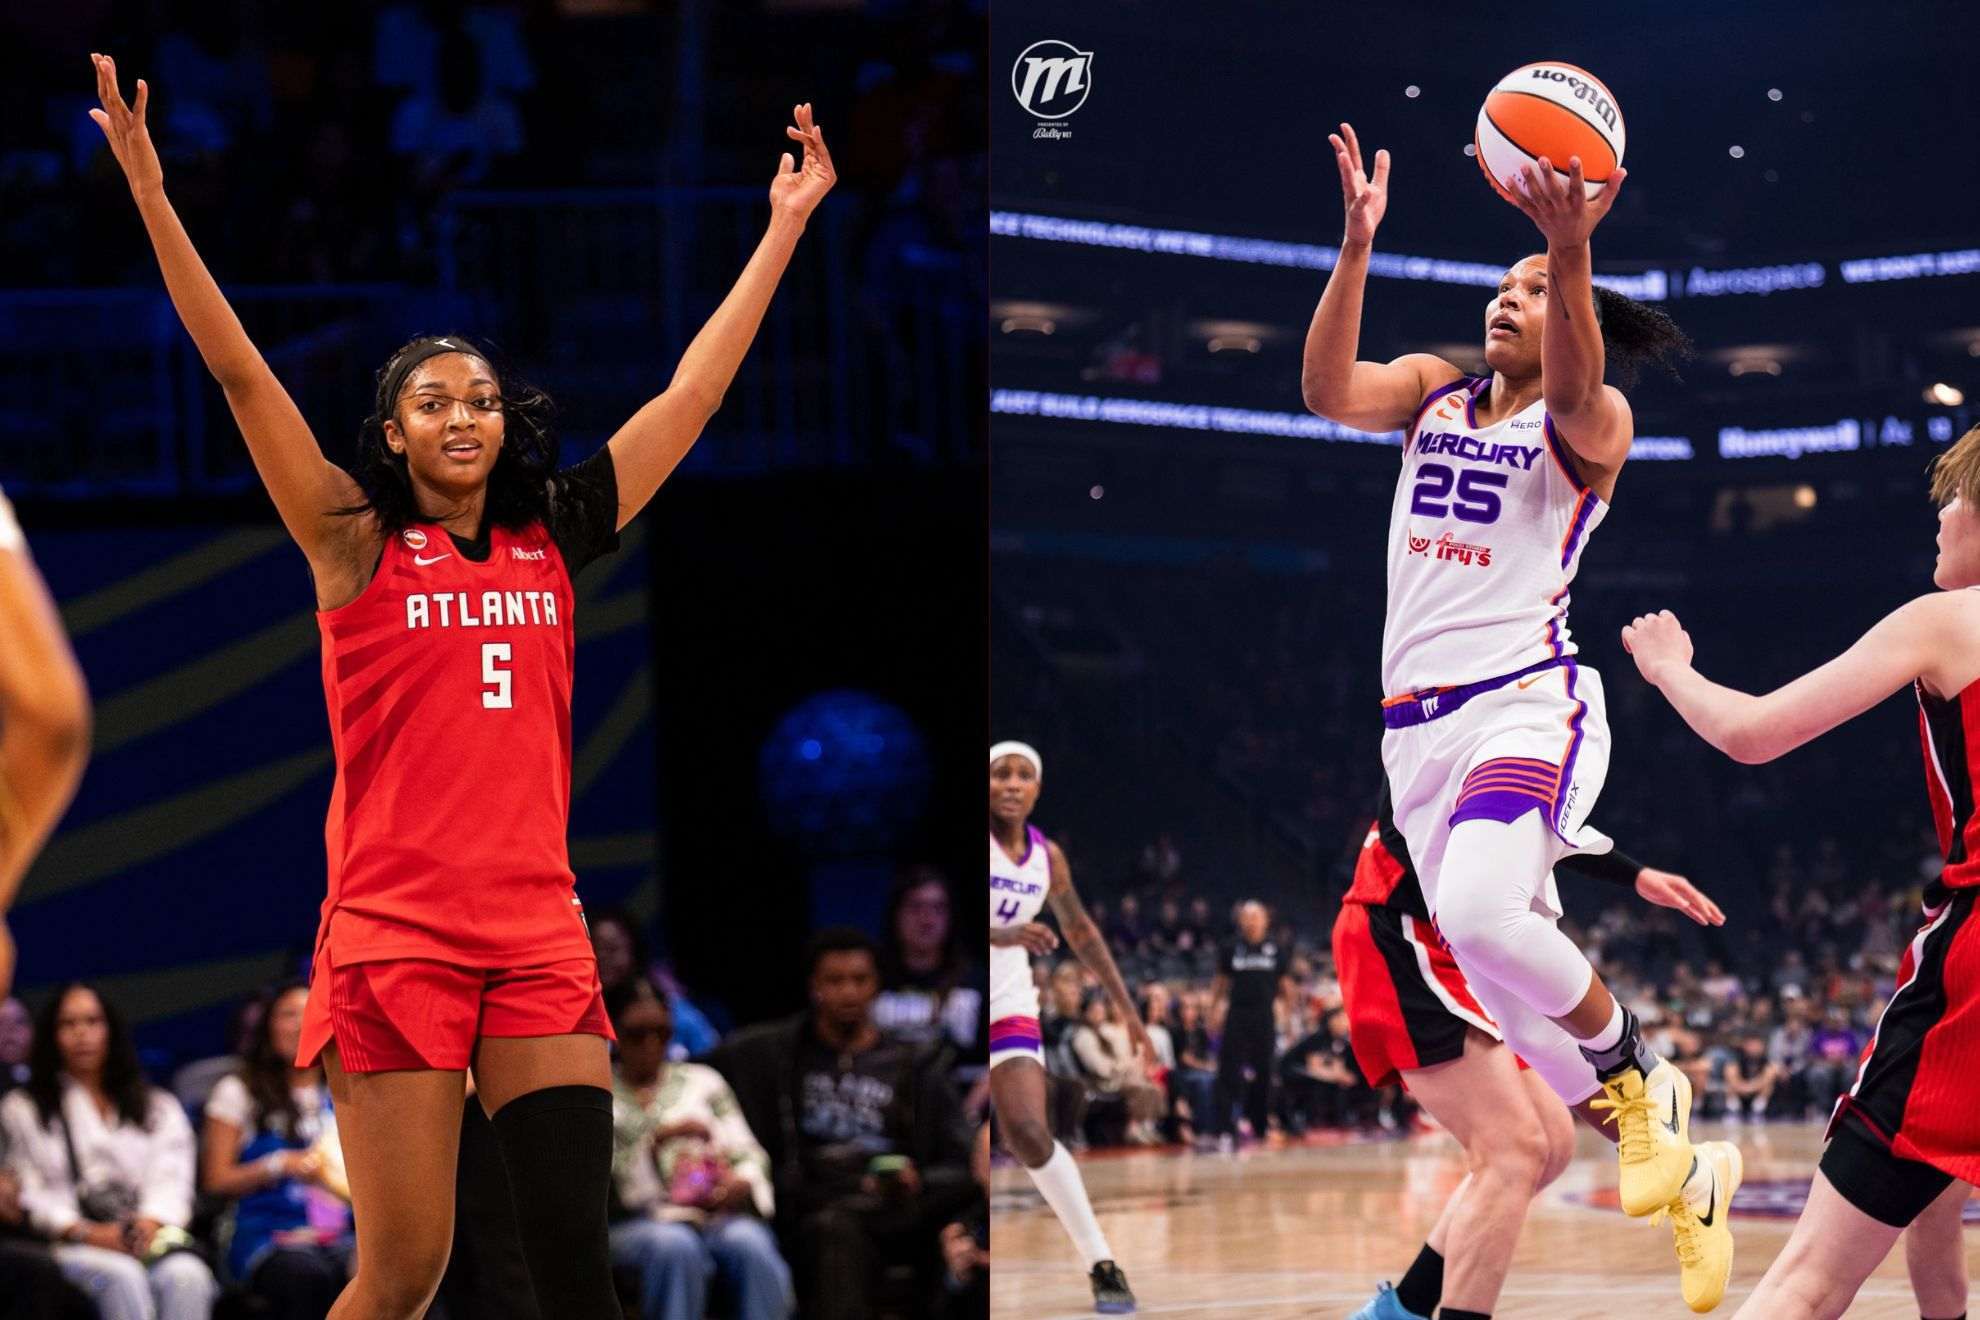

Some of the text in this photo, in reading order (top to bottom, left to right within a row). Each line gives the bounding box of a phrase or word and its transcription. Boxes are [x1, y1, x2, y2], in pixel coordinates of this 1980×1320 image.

[1531, 69, 1617, 133] Wilson
[1686, 262, 1825, 296] Aerospace
[1510, 419, 1542, 430] HERO
[1718, 418, 1861, 460] Honeywell
[1415, 430, 1544, 471] MERCURY
[1410, 463, 1508, 525] 25
[512, 547, 545, 560] Albert
[406, 591, 558, 629] ATLANTA
[481, 643, 513, 709] 5
[996, 898, 1021, 925] 4
